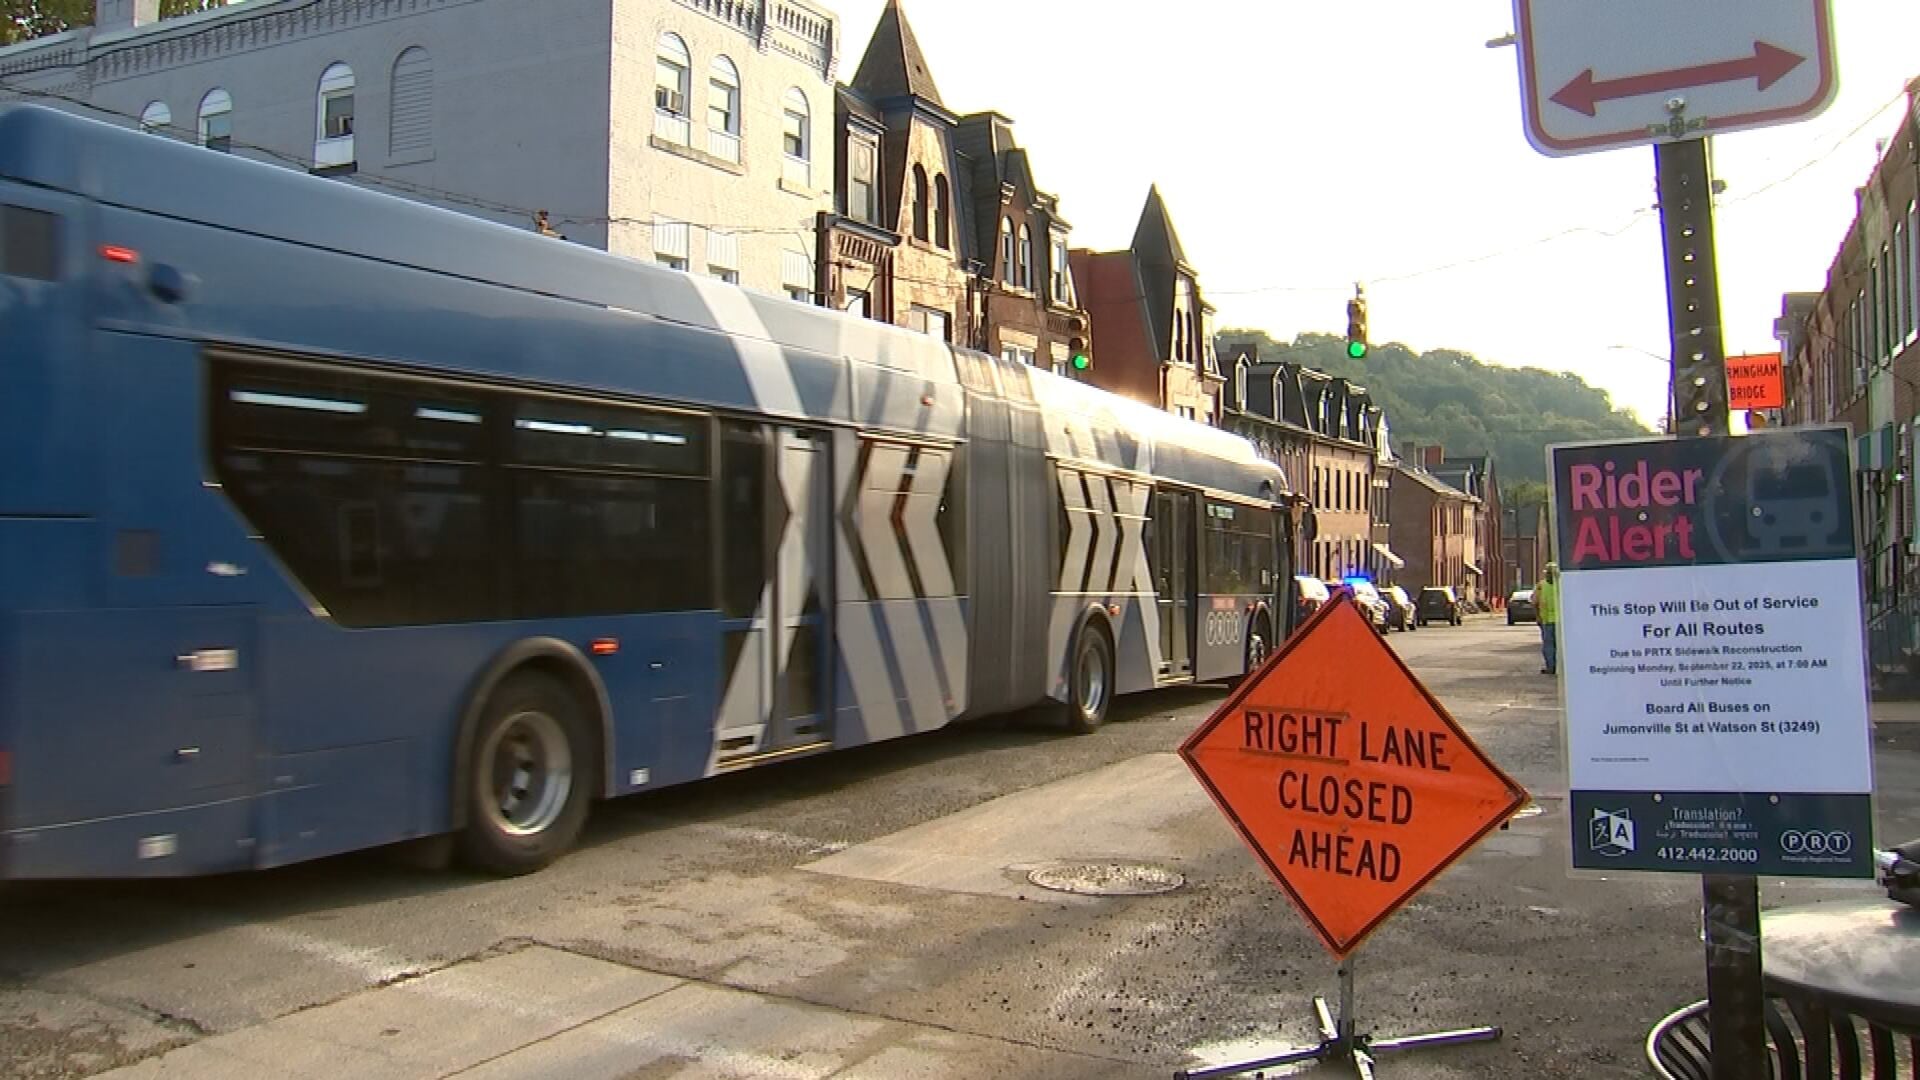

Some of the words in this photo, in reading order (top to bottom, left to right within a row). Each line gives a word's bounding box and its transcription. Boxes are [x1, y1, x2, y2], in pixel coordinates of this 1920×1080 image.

[1730, 385, 1766, 400] BRIDGE
[1571, 461, 1703, 510] Rider
[1572, 516, 1696, 564] Alert
[1591, 604, 1620, 616] This
[1624, 604, 1656, 616] Stop
[1660, 602, 1686, 613] Will
[1714, 600, 1740, 610] Out
[1744, 598, 1759, 610] of
[1763, 596, 1819, 609] Service
[1643, 625, 1671, 638] For
[1676, 623, 1698, 636] All
[1704, 622, 1765, 636] Routes
[1610, 649, 1630, 658] Due
[1632, 649, 1642, 657] to
[1645, 647, 1672, 657] PRTX
[1723, 645, 1802, 655] Reconstruction
[1590, 665, 1636, 675] Beginning
[1679, 663, 1728, 672] September
[1776, 661, 1785, 669] at
[1811, 659, 1828, 667] AM
[1684, 677, 1719, 686] Further
[1721, 677, 1752, 686] Notice
[1646, 703, 1685, 715] Board
[1687, 702, 1705, 713] All
[1708, 702, 1750, 713] Buses
[1753, 703, 1771, 713] on
[1602, 723, 1671, 735] Jumonville
[1675, 721, 1689, 733] St
[1692, 722, 1705, 733] at
[1708, 721, 1757, 733] Watson
[1761, 721, 1776, 733] St
[1778, 720, 1821, 735] (3249)
[1245, 711, 1342, 757] RIGHT
[1361, 721, 1450, 772] LANE
[1278, 769, 1413, 825] CLOSED
[1673, 807, 1743, 821] Translation?
[1289, 830, 1401, 883] AHEAD
[1657, 847, 1759, 863] 412.442.2000
